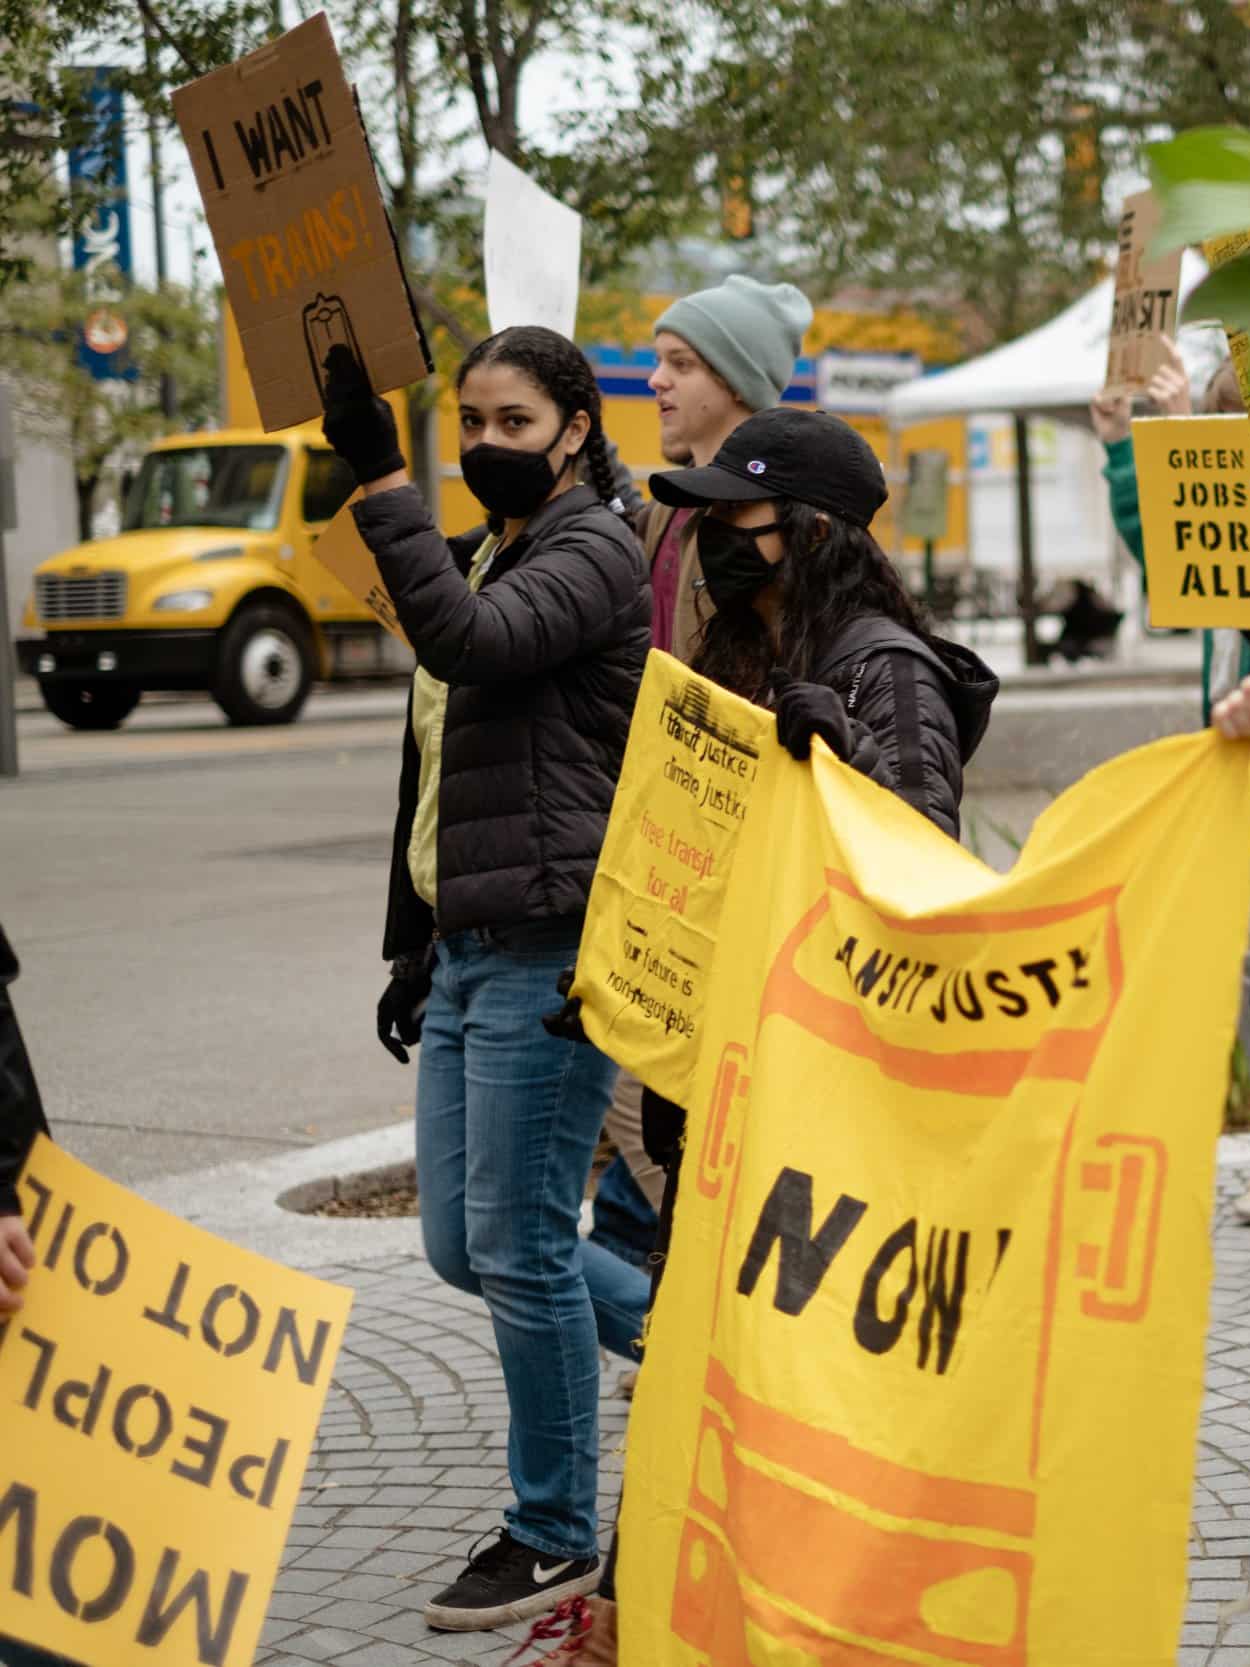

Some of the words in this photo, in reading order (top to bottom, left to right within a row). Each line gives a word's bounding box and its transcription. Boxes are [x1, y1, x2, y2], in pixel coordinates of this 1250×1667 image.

[202, 128, 225, 190] I
[233, 79, 332, 178] WANT
[230, 184, 374, 305] TRAINS!
[1168, 449, 1246, 470] GREEN
[1173, 481, 1248, 508] JOBS
[1174, 521, 1250, 552] FOR
[700, 734, 749, 780] justice
[645, 864, 670, 900] for
[641, 946, 679, 989] future
[681, 973, 694, 999] is
[25, 1174, 131, 1297] OIL
[142, 1262, 332, 1386] NOT
